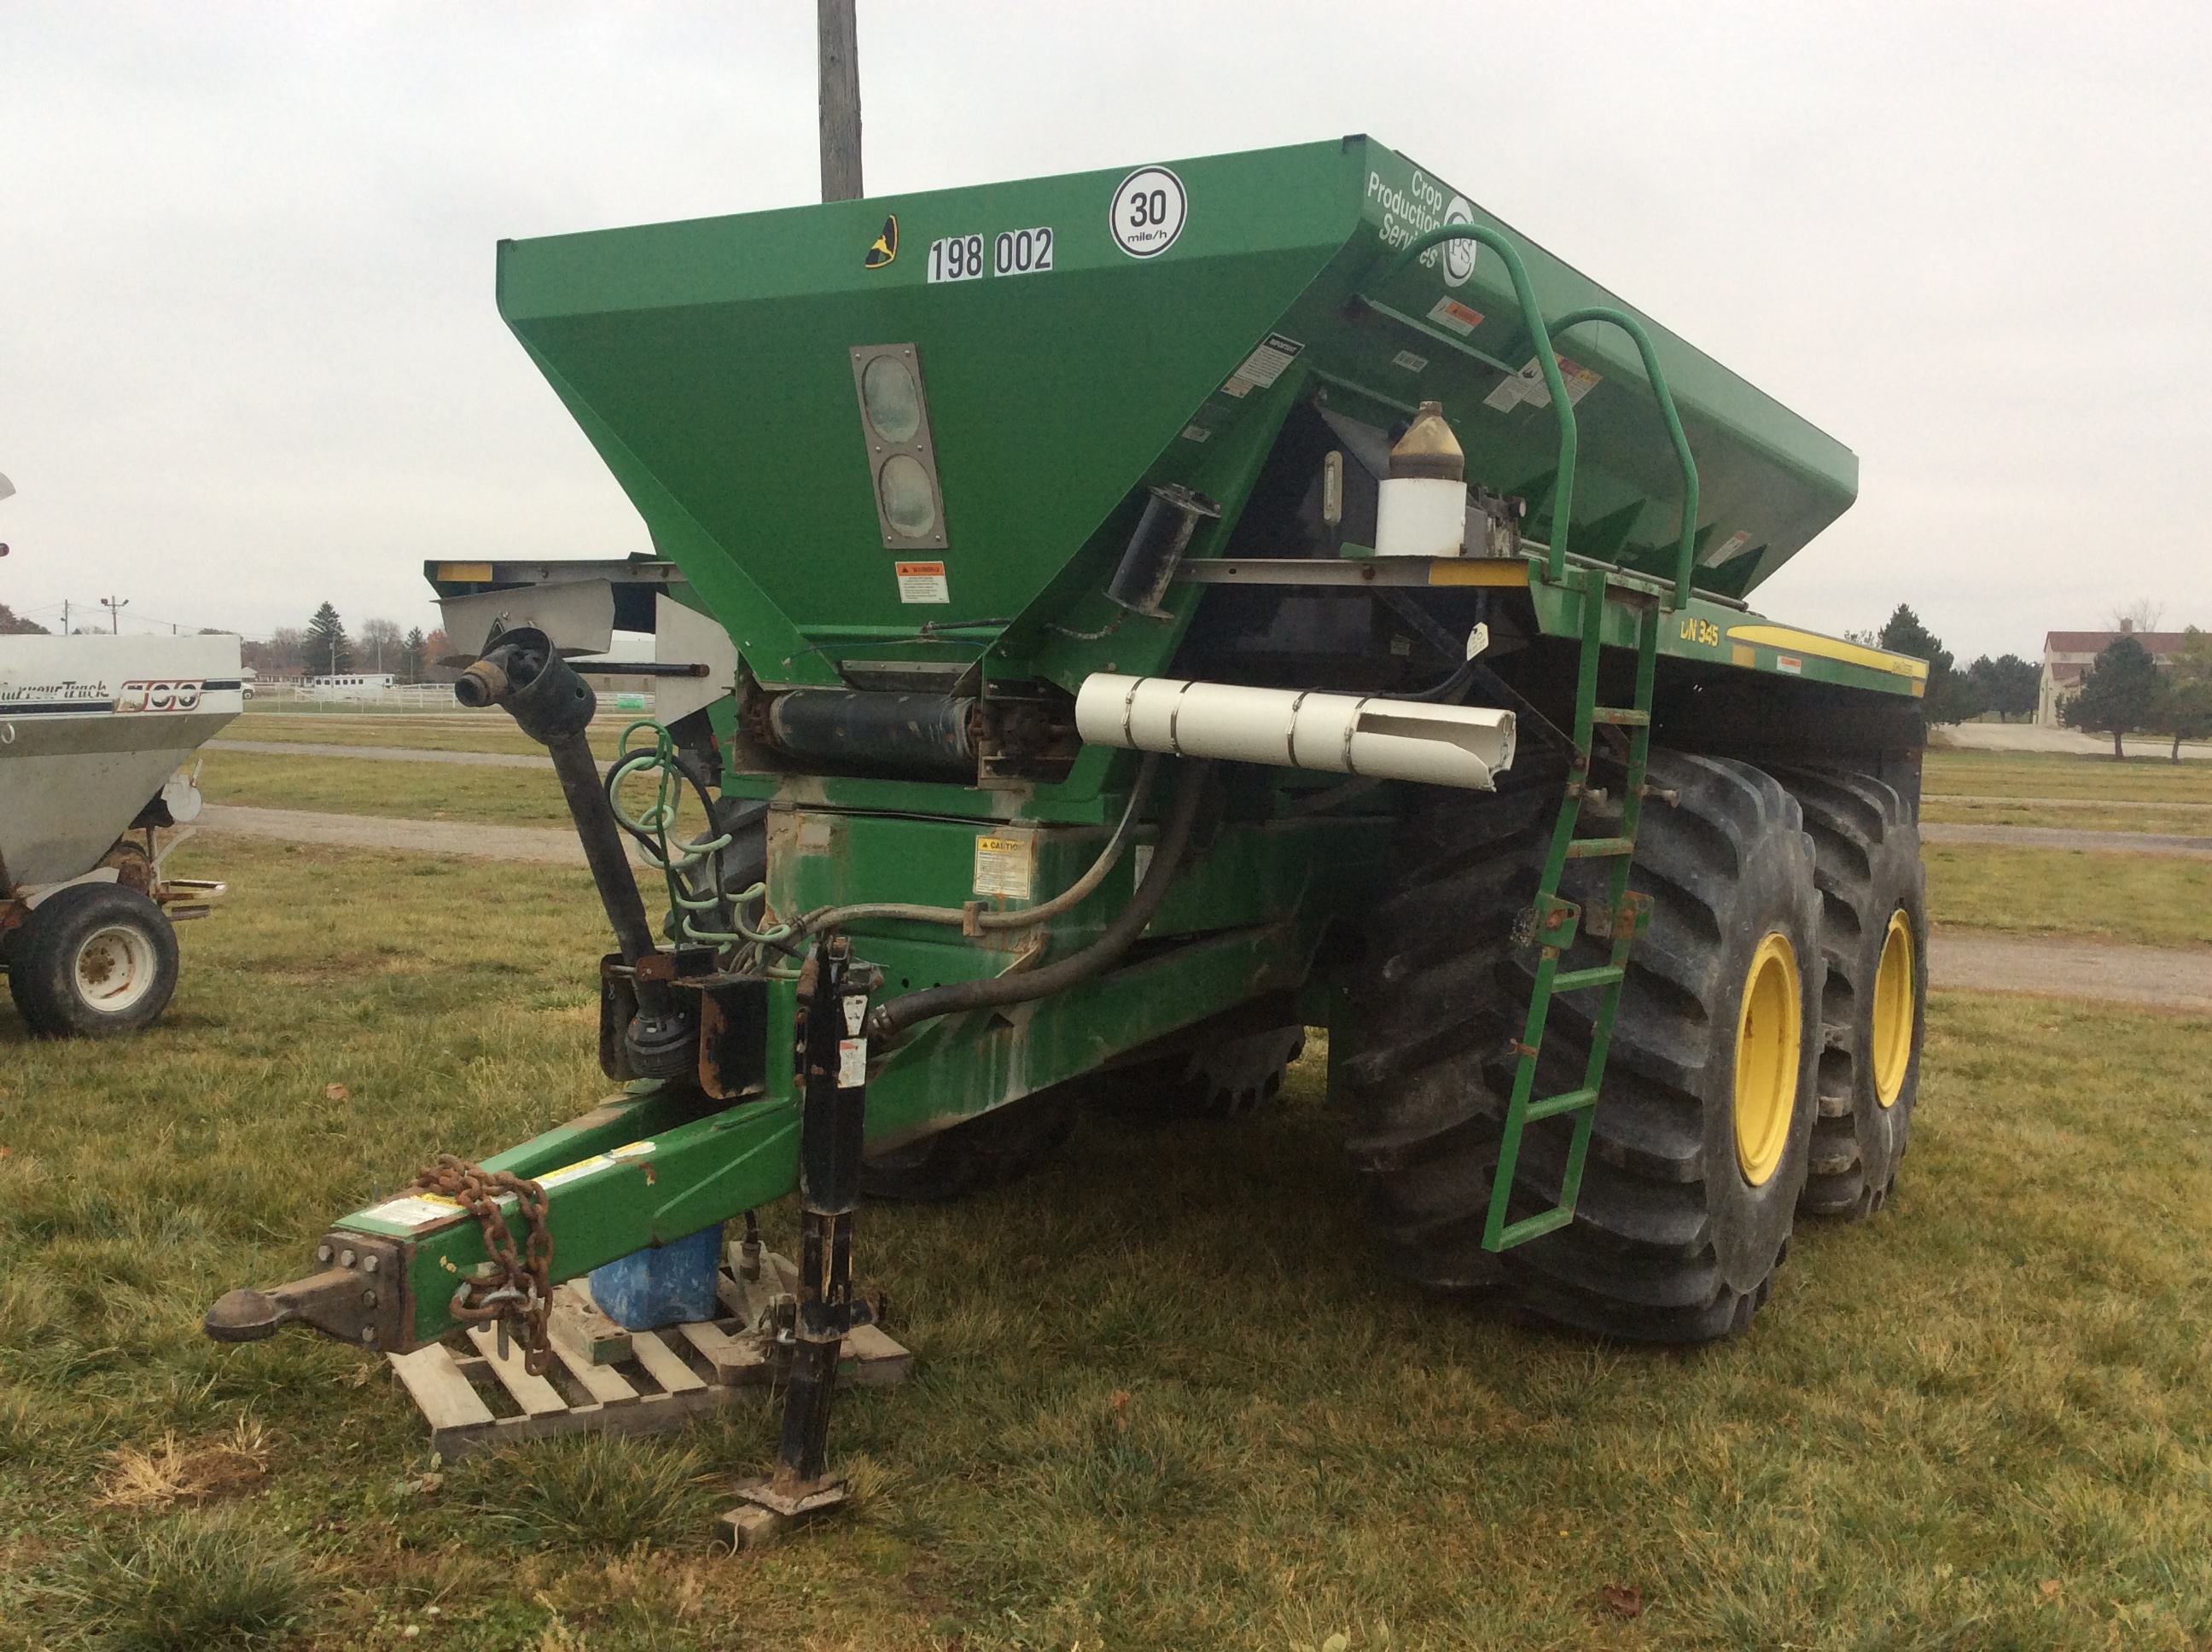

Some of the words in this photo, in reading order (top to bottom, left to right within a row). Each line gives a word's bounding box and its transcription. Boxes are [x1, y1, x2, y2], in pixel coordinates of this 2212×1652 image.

[1129, 189, 1167, 228] 30
[1367, 171, 1441, 233] Production
[1412, 170, 1442, 214] Crop
[933, 236, 982, 282] 198
[997, 228, 1051, 274] 002
[1126, 230, 1167, 244] mile/h
[1379, 212, 1438, 269] Serves
